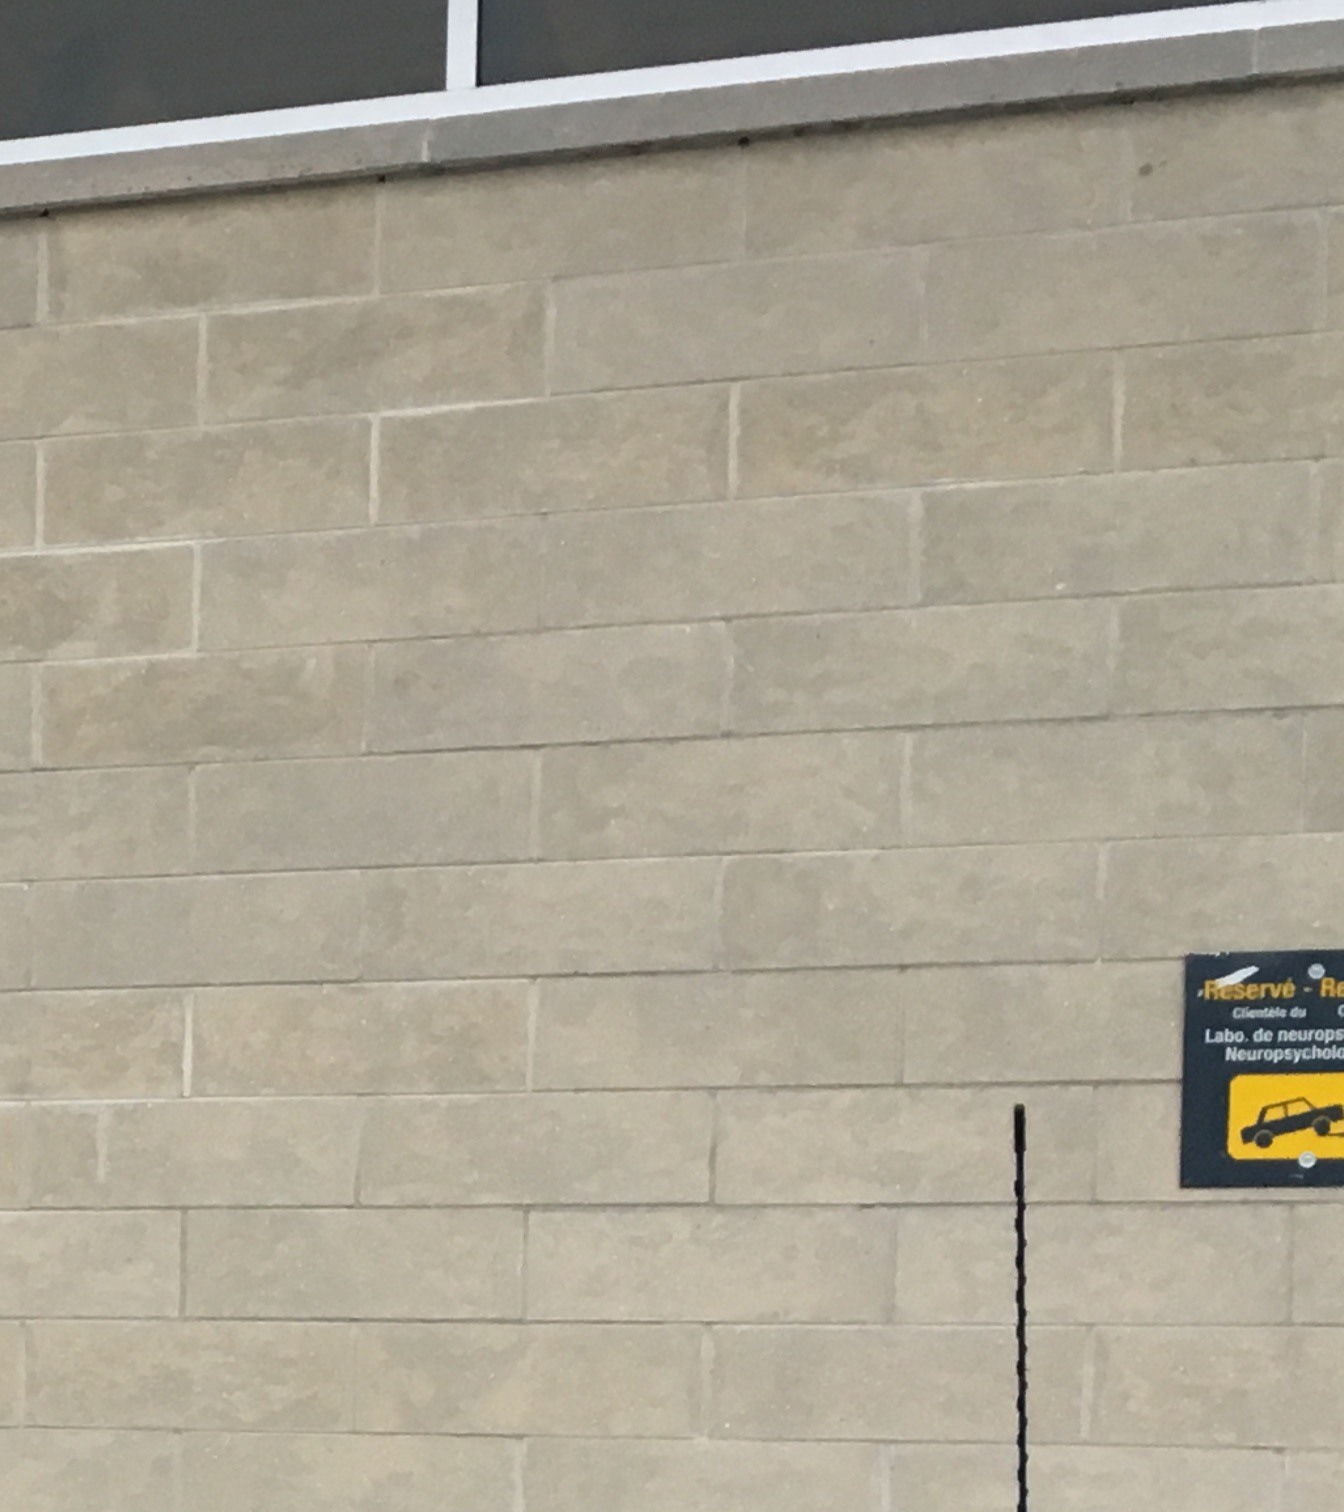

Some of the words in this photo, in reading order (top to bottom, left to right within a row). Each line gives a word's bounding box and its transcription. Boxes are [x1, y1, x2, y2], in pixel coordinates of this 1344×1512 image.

[1289, 1005, 1307, 1018] du
[1205, 1028, 1249, 1044] Labo.
[1252, 1028, 1274, 1043] de
